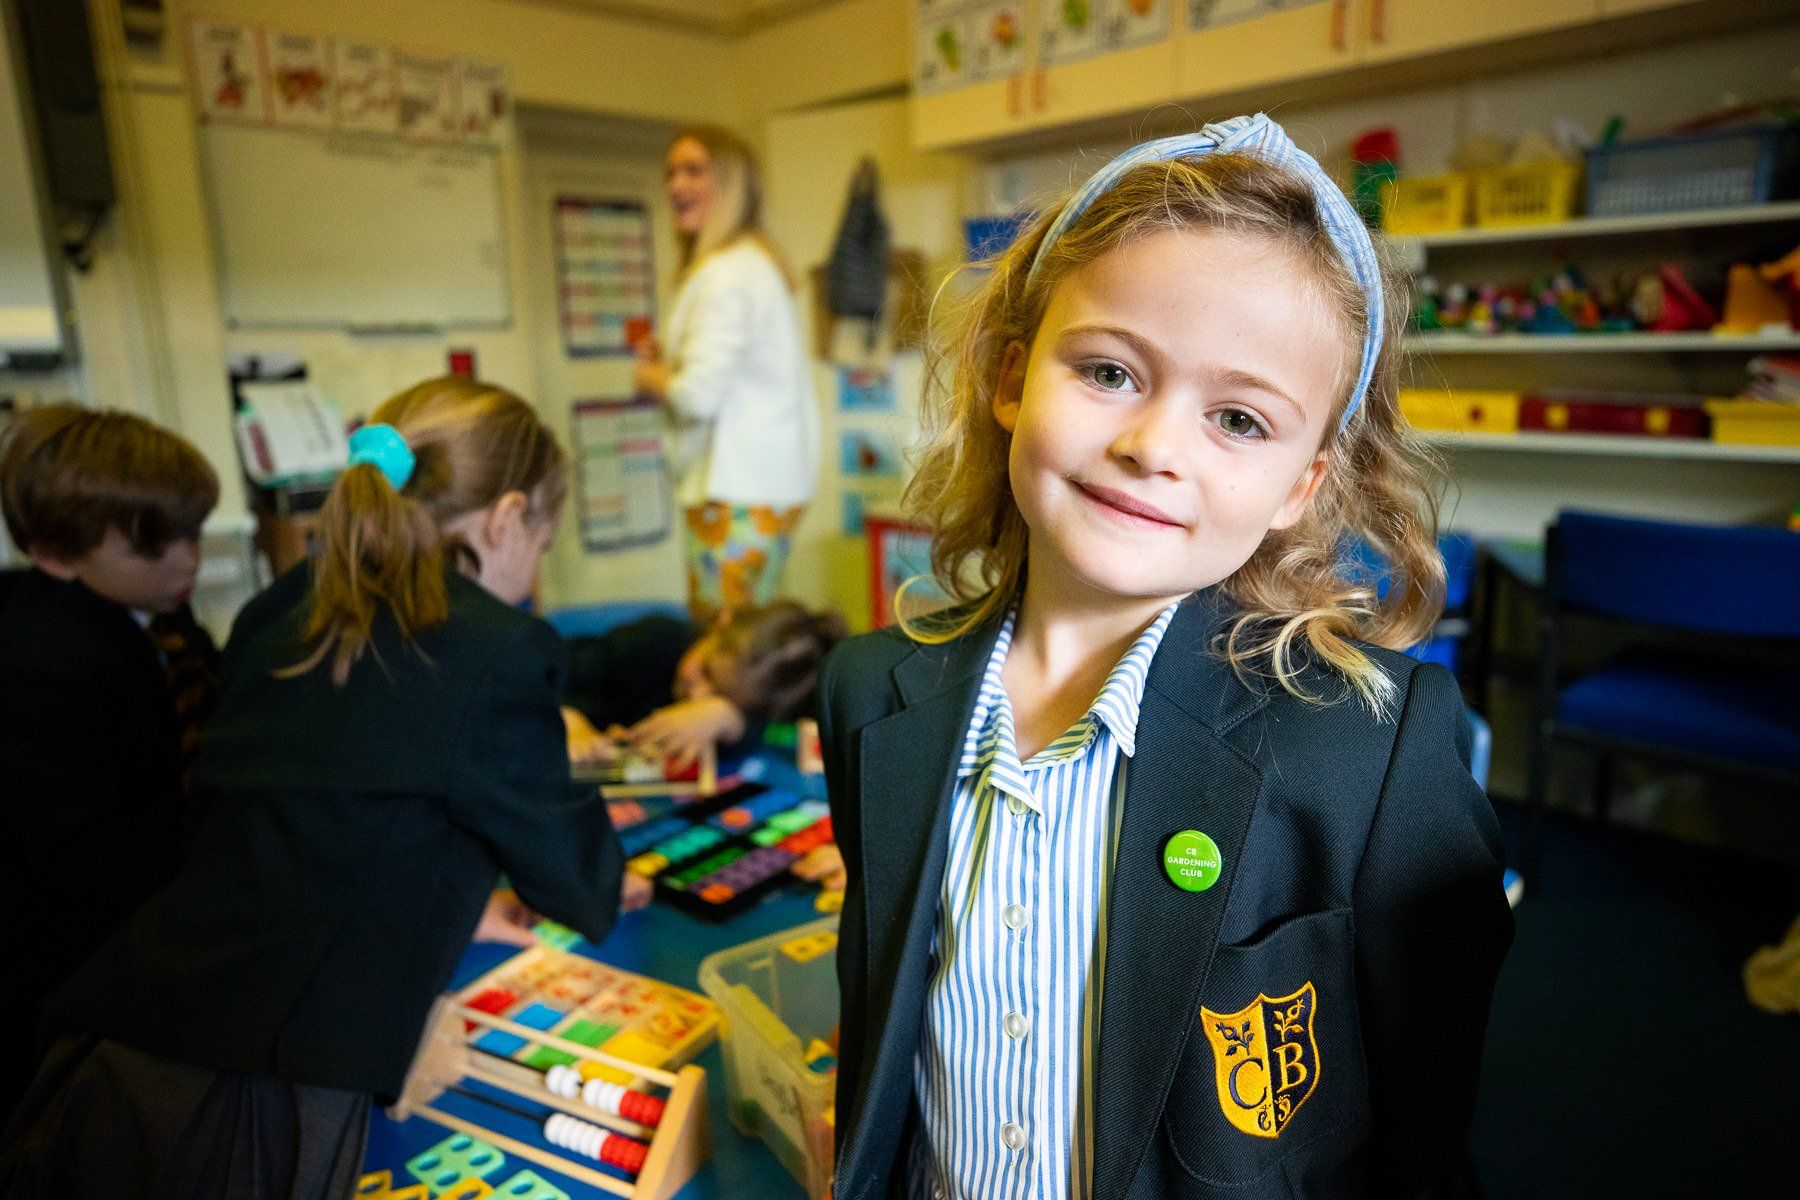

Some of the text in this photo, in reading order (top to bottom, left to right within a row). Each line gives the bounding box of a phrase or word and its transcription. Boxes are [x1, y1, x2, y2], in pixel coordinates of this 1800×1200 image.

[1186, 847, 1197, 856] CB
[1167, 856, 1217, 868] GARDENING
[1180, 868, 1203, 878] CLUB
